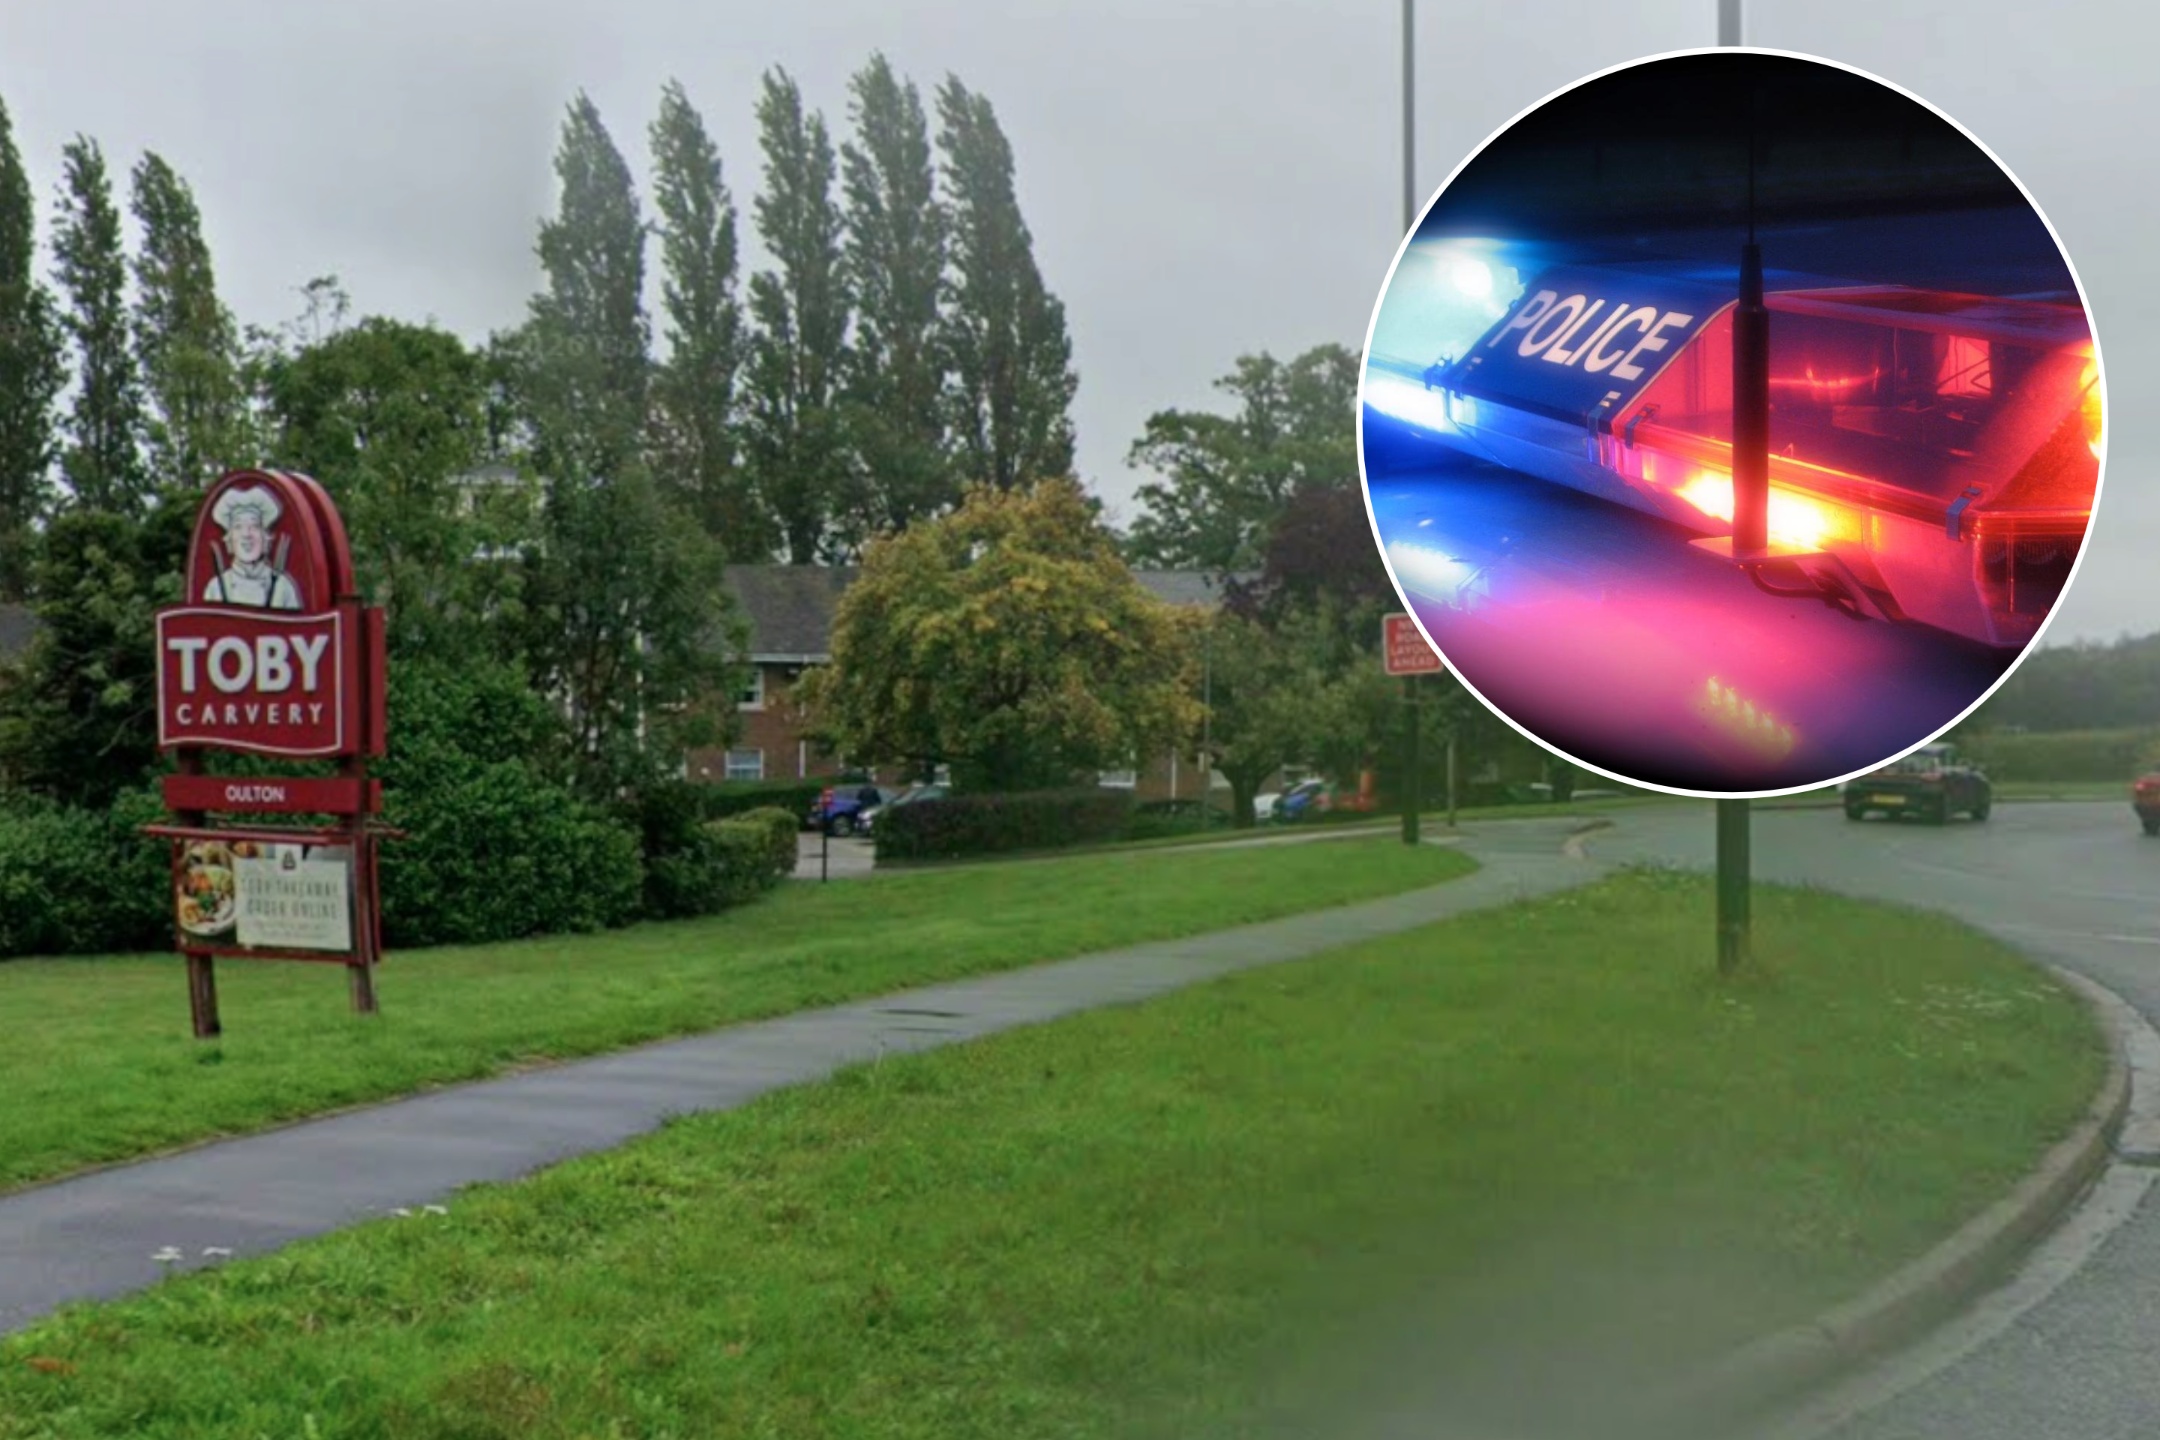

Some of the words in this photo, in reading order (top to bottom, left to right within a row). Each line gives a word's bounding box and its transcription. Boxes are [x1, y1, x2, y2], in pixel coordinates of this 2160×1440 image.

[1487, 289, 1694, 382] POLICE
[1390, 643, 1430, 656] LAYOU
[167, 634, 329, 694] TOBY
[176, 703, 323, 726] CARVERY
[225, 785, 285, 802] OULTON
